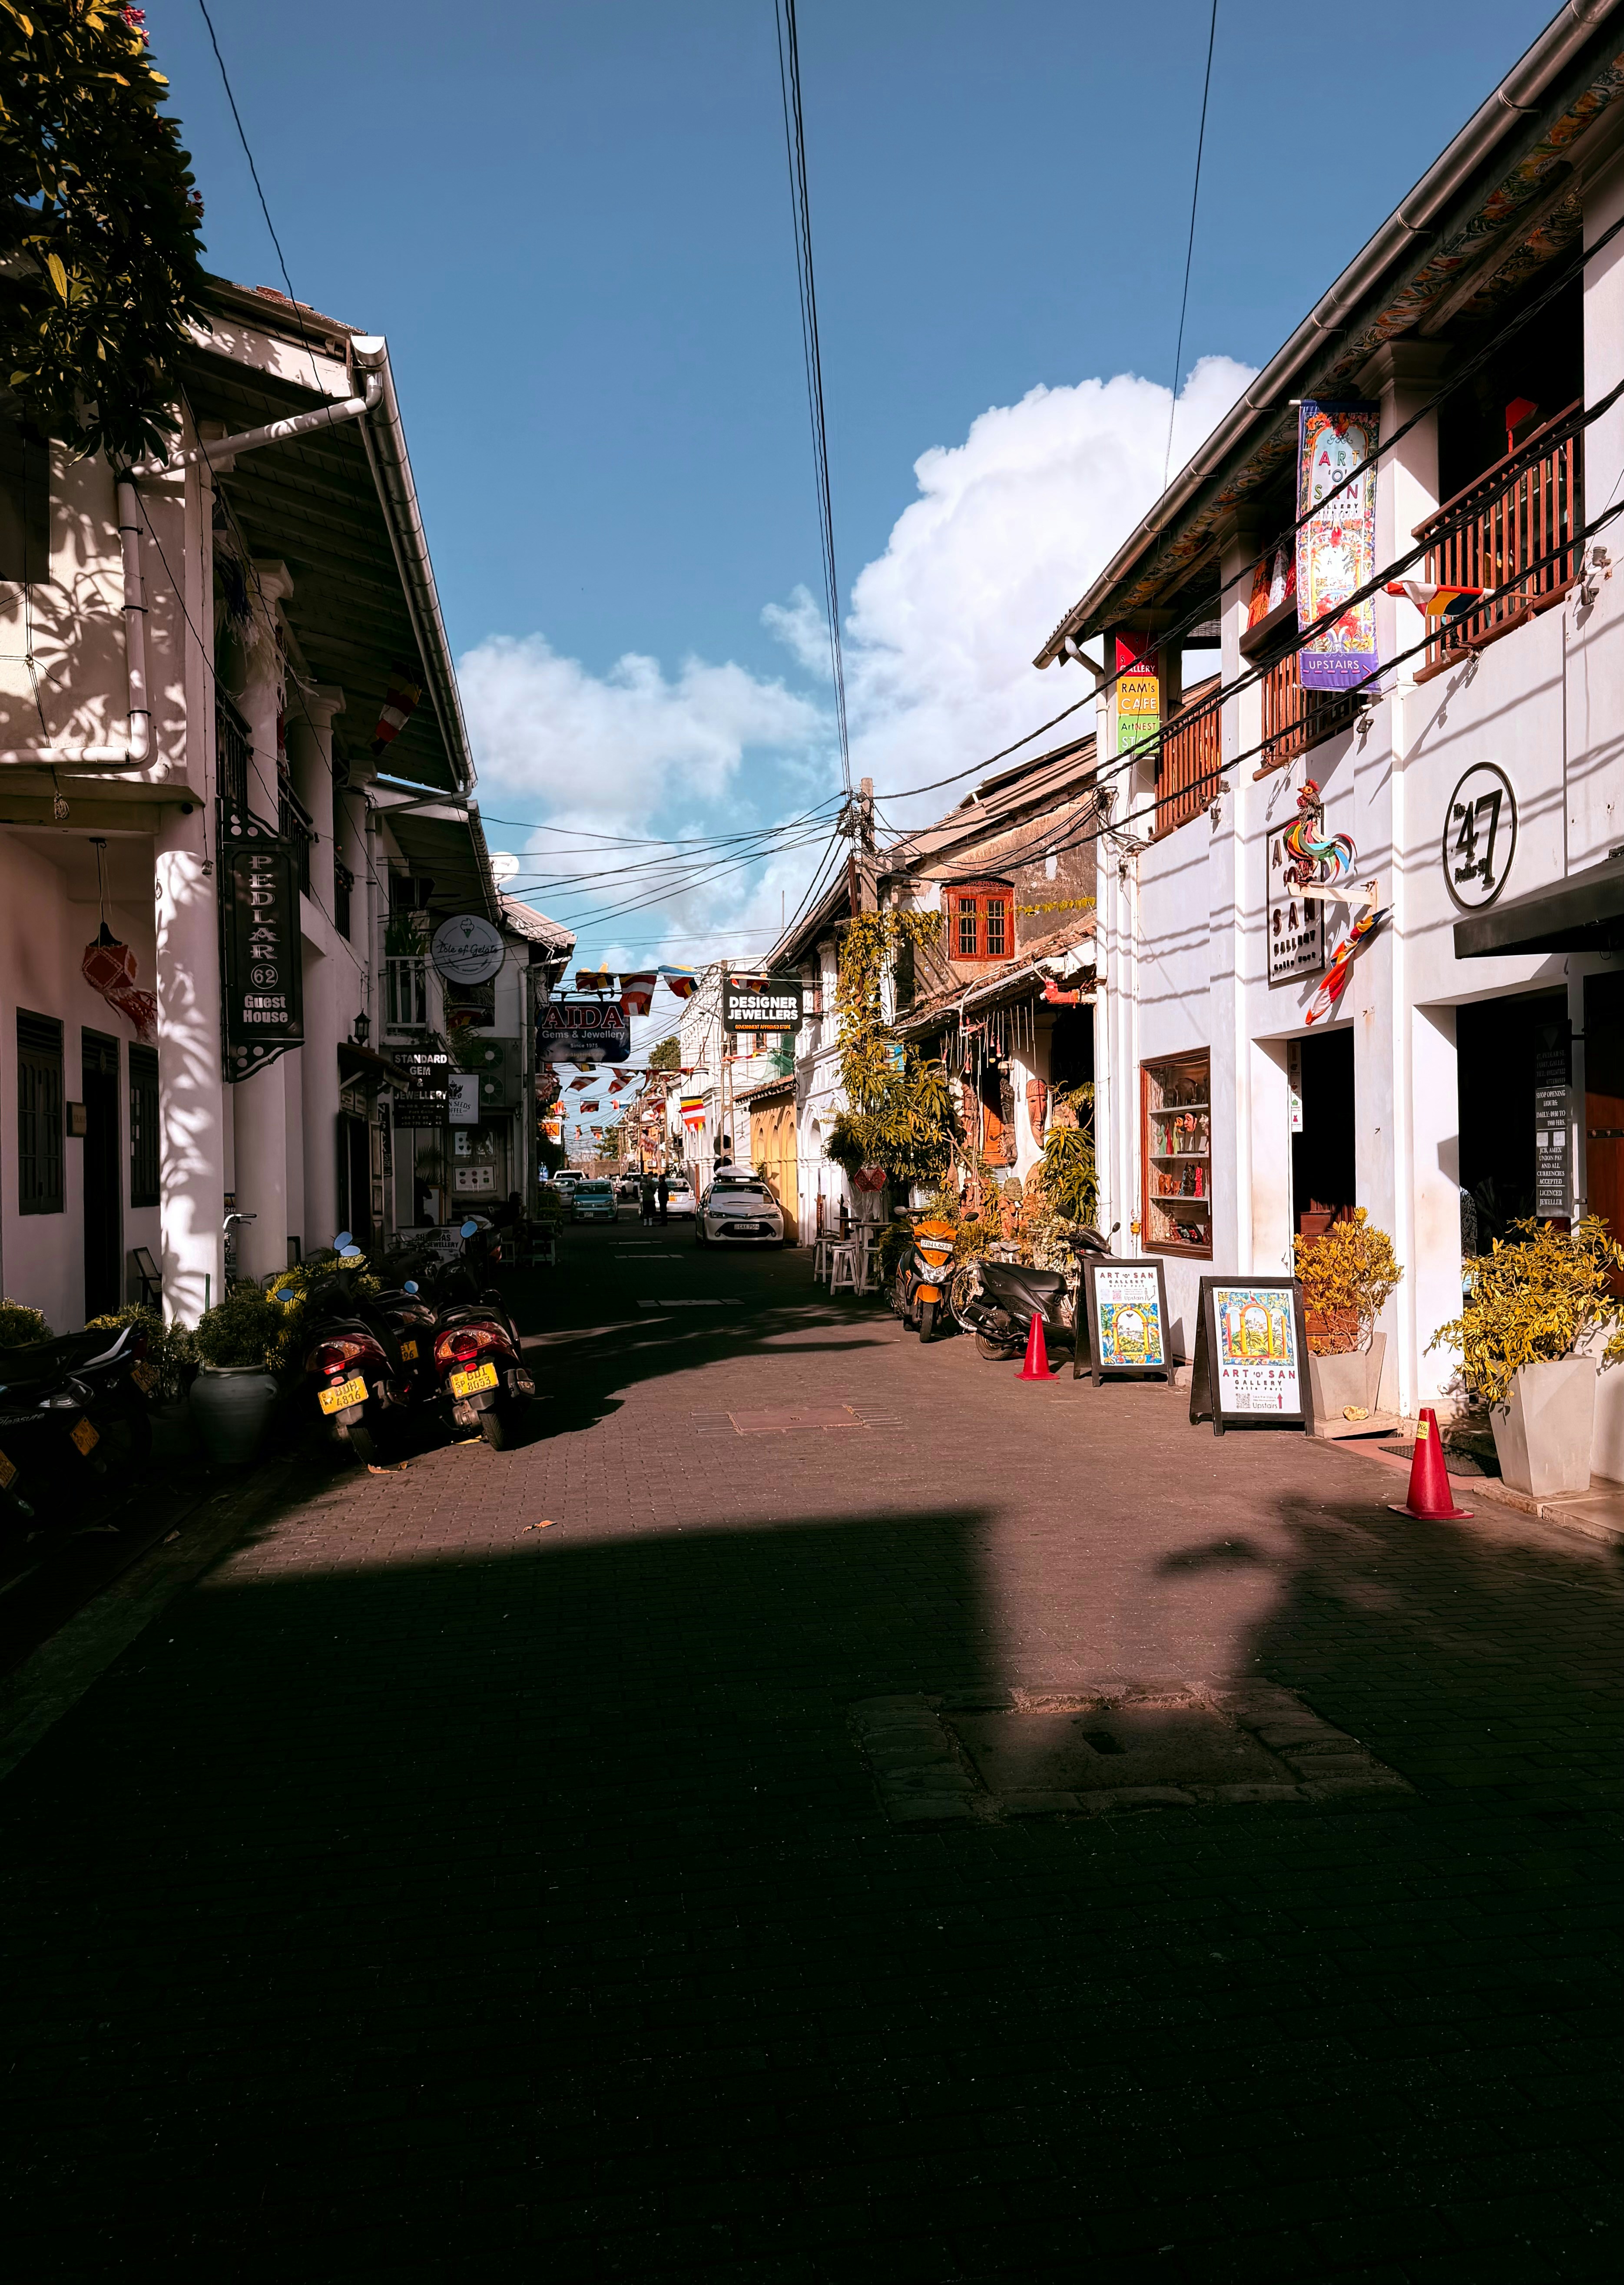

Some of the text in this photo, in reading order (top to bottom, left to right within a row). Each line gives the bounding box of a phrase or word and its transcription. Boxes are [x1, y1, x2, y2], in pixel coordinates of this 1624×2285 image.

[1319, 450, 1359, 466] ART
[1309, 660, 1359, 669] UPSTAIRS
[1122, 683, 1155, 693] RAM's
[1121, 698, 1157, 710] CAFE
[1456, 789, 1503, 884] 47
[248, 855, 281, 960] PEDLAR
[1273, 897, 1315, 934] SAN
[458, 944, 468, 956] of
[253, 969, 276, 984] 62
[244, 994, 286, 1009] Guest
[729, 996, 797, 1008] DESIGNER
[243, 1009, 288, 1023] House
[542, 1006, 626, 1029] AIDA
[727, 1009, 799, 1020] JEWELLERS
[572, 1030, 579, 1038] &
[581, 1030, 625, 1040] Jewellery
[394, 1054, 447, 1063] STANDARD
[410, 1066, 431, 1076] GEM
[417, 1078, 424, 1087] &
[394, 1090, 447, 1100] JEWELLERY
[454, 1101, 471, 1109] SEEDS
[1223, 1369, 1249, 1378] ART
[1269, 1370, 1295, 1379] SAN
[455, 1380, 465, 1388] SP
